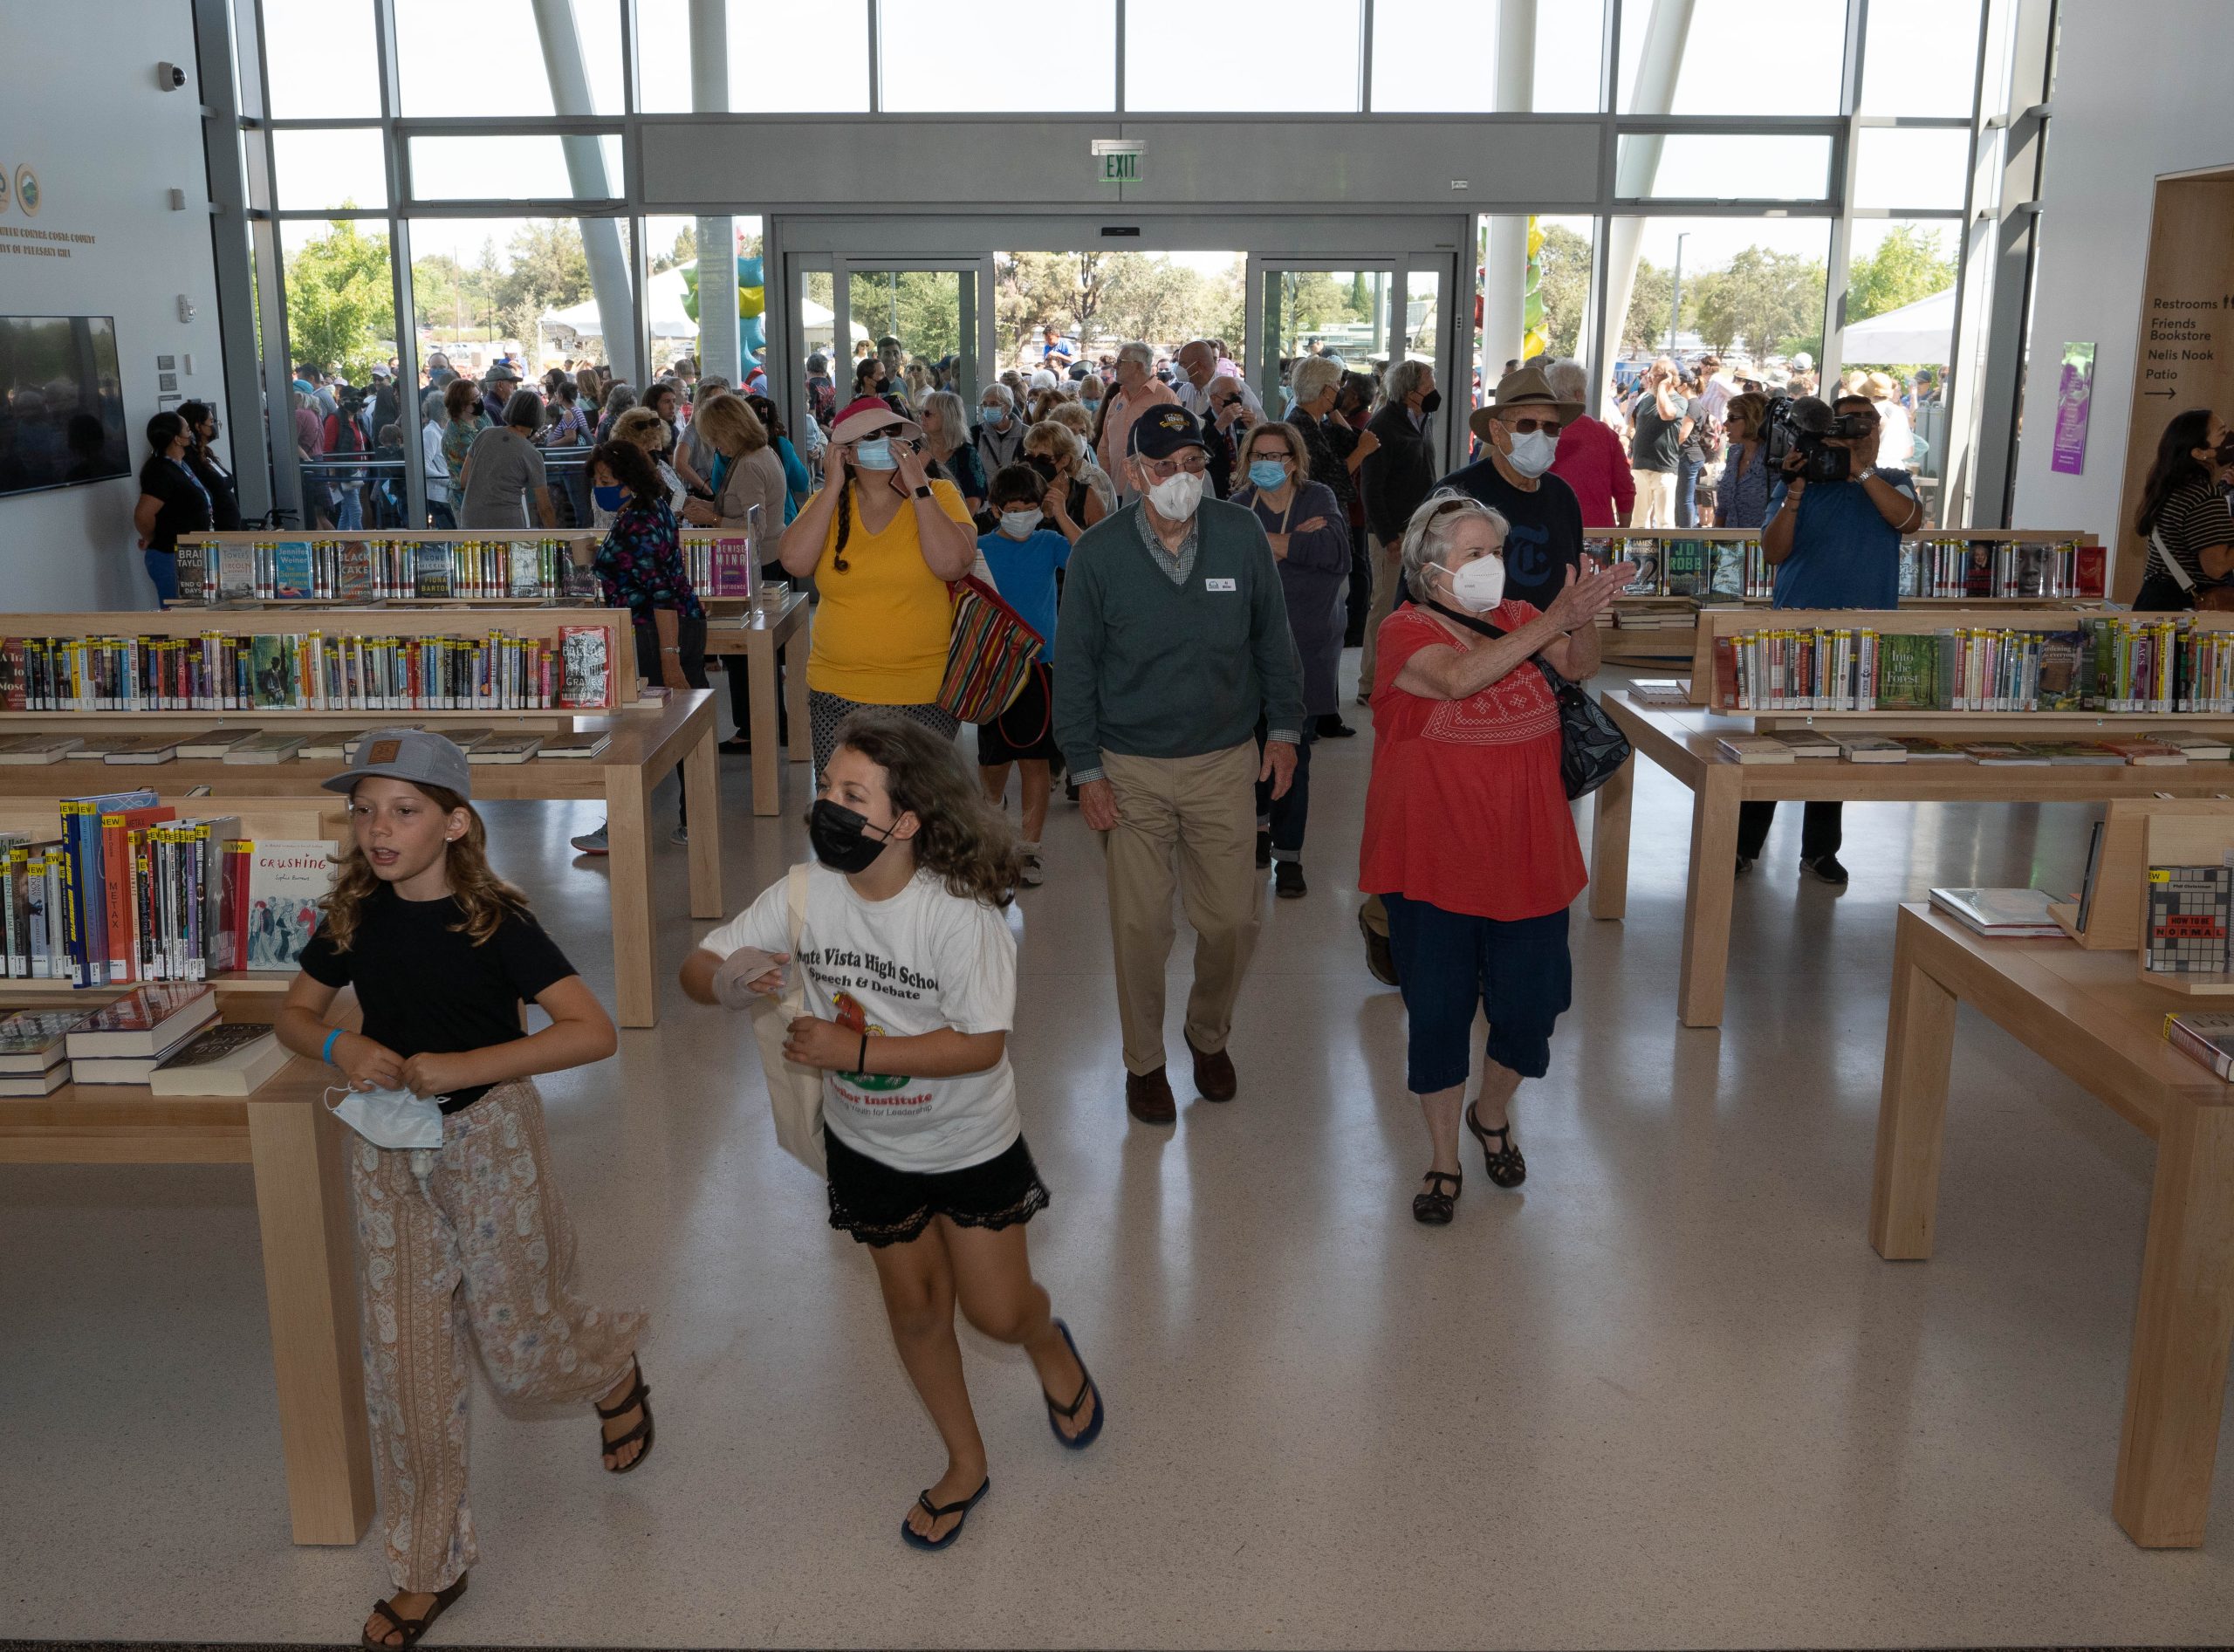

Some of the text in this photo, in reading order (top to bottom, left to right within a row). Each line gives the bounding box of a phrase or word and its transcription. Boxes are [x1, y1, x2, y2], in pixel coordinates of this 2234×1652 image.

[1107, 154, 1136, 177] EXIT
[2154, 298, 2217, 309] Restrooms
[2151, 318, 2196, 329] Friends
[2150, 330, 2211, 341] Bookstore
[2148, 350, 2214, 360] Nelis Nook
[2146, 369, 2177, 379] Patio
[716, 545, 747, 553] DENISE
[339, 553, 371, 562] BLACK
[716, 554, 747, 566] MINA
[1670, 557, 1702, 570] ROBB
[10, 653, 24, 661] Tra
[1892, 650, 1914, 661] Into
[1895, 662, 1911, 672] the
[1888, 671, 1918, 683] Forest
[109, 881, 119, 929] METAX
[2172, 916, 2188, 925] HOW
[2156, 928, 2223, 936] NORMAL
[825, 948, 860, 967] Vista
[865, 953, 895, 979] High
[809, 967, 921, 1000] Speech & Debate
[864, 1093, 933, 1106] Institute
[887, 1104, 933, 1117] Leadership
